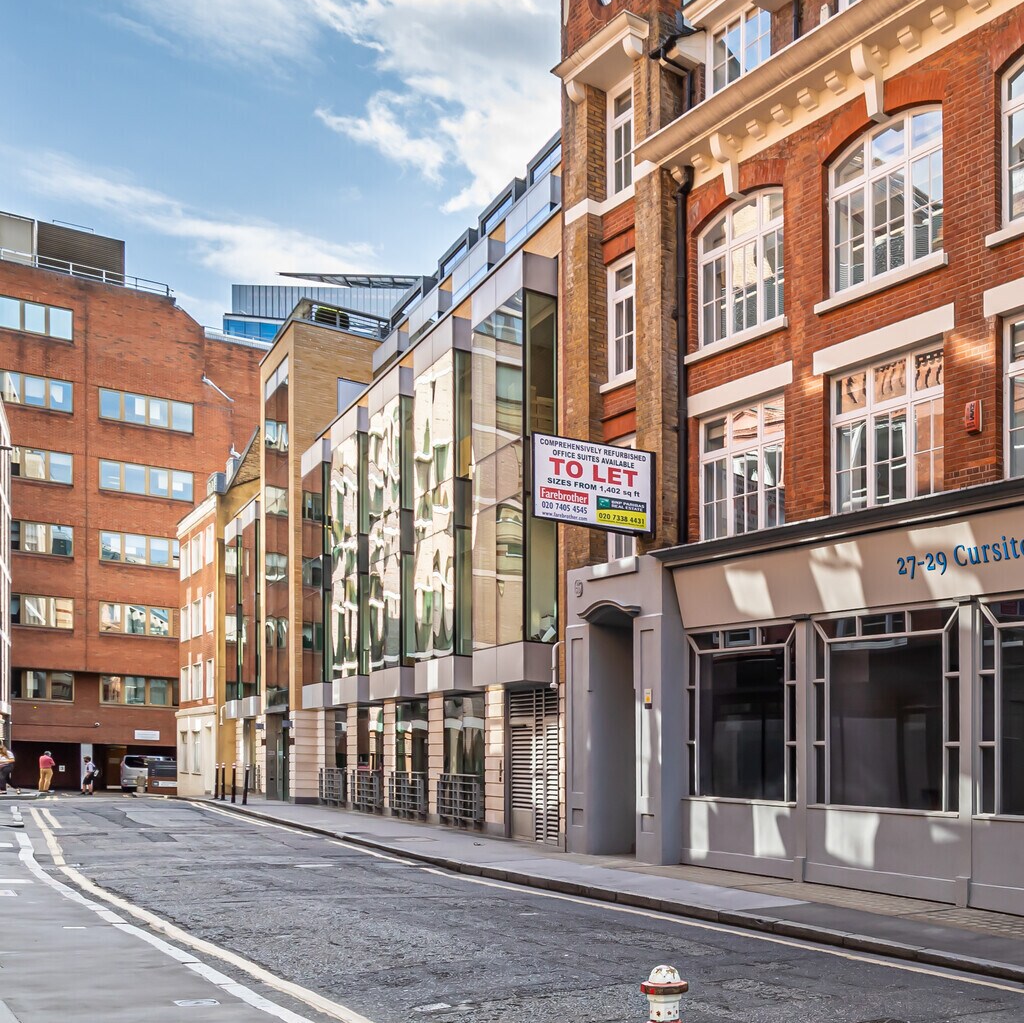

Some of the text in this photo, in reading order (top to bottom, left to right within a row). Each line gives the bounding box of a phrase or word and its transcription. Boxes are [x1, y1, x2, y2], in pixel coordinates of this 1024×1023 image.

[540, 438, 646, 462] COMPREHENSIVELY REFURBISHED
[552, 449, 635, 469] OFFICE SUITES AVAILABLE
[549, 457, 638, 487] TO LET
[547, 477, 572, 487] SIZES
[574, 481, 597, 491] FROM
[600, 485, 621, 494] 1,402
[541, 488, 587, 503] Farebrother
[541, 501, 588, 515] 020 7405 4545
[541, 511, 588, 521] www.farebrother.com
[598, 512, 611, 520] 020
[612, 514, 628, 523] 7338
[629, 517, 645, 525] 4431
[896, 551, 948, 580] 27-29
